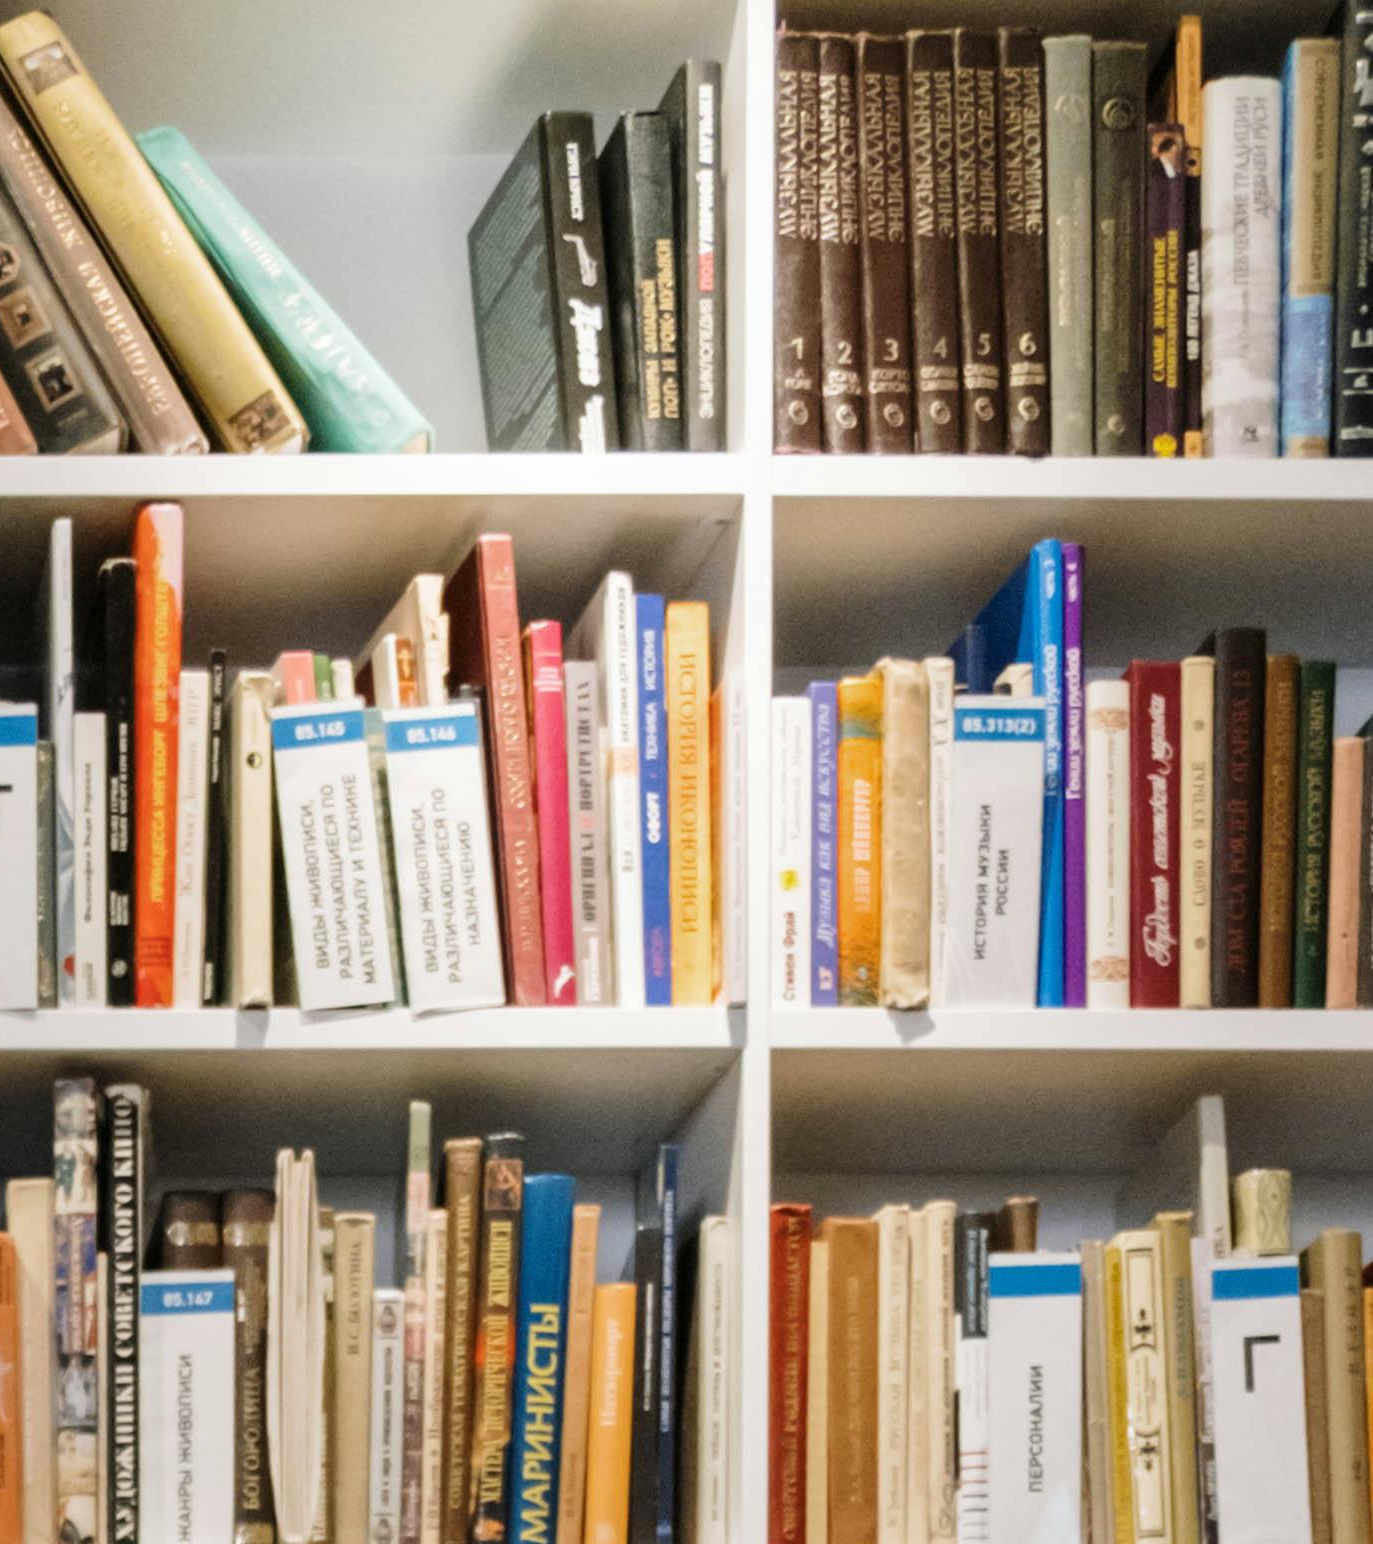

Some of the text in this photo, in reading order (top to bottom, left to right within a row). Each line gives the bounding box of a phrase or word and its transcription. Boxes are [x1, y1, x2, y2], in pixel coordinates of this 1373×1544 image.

[792, 339, 804, 360] 1
[837, 342, 852, 364] 2
[883, 339, 899, 361] 3
[933, 338, 947, 359] 4
[977, 334, 991, 356] 5
[1020, 334, 1036, 356] 6
[961, 715, 1037, 736] 85.313(2)
[645, 792, 662, 844] ОФОРТ
[677, 652, 700, 933] ИСТОРИЯ ИКОНОПИСИ
[298, 799, 332, 968] ВИДЫ ЖИВОПИСИ,
[320, 784, 354, 979] РАЗЛИЧАЮЩИЕСЯ ПО
[340, 774, 378, 984] МАТЕРИАЛУ И ТЕХНИКЕ
[410, 802, 441, 974] ВИДЫ ЖИВОПИСИ,
[431, 788, 463, 983] РАЗЛИЧАЮЩИЕСЯ ПО
[456, 822, 481, 946] НАЗНАЧЕНИЮ
[974, 803, 992, 960] ИСТОРИЯ МУЗЫКИ
[995, 847, 1010, 916] РОССИИ
[113, 1098, 136, 1542] ХУДОЖНИКИ СОВЕТСКОГО КИНО
[481, 1221, 512, 1504] МАСТЕРА ИСТОРИЧЕСКОЙ ЖИВОПИСИ
[600, 1318, 622, 1427] Натюрморт
[1242, 1335, 1280, 1393] Г
[176, 1354, 194, 1543] ЖАНРЫ ЖИВОПИСИ
[241, 1367, 262, 1511] БОГОРОДИЦА
[519, 1303, 561, 1544] МАРИНИСТЫ
[1026, 1364, 1044, 1494] ПЕРСОНАЛИИ
